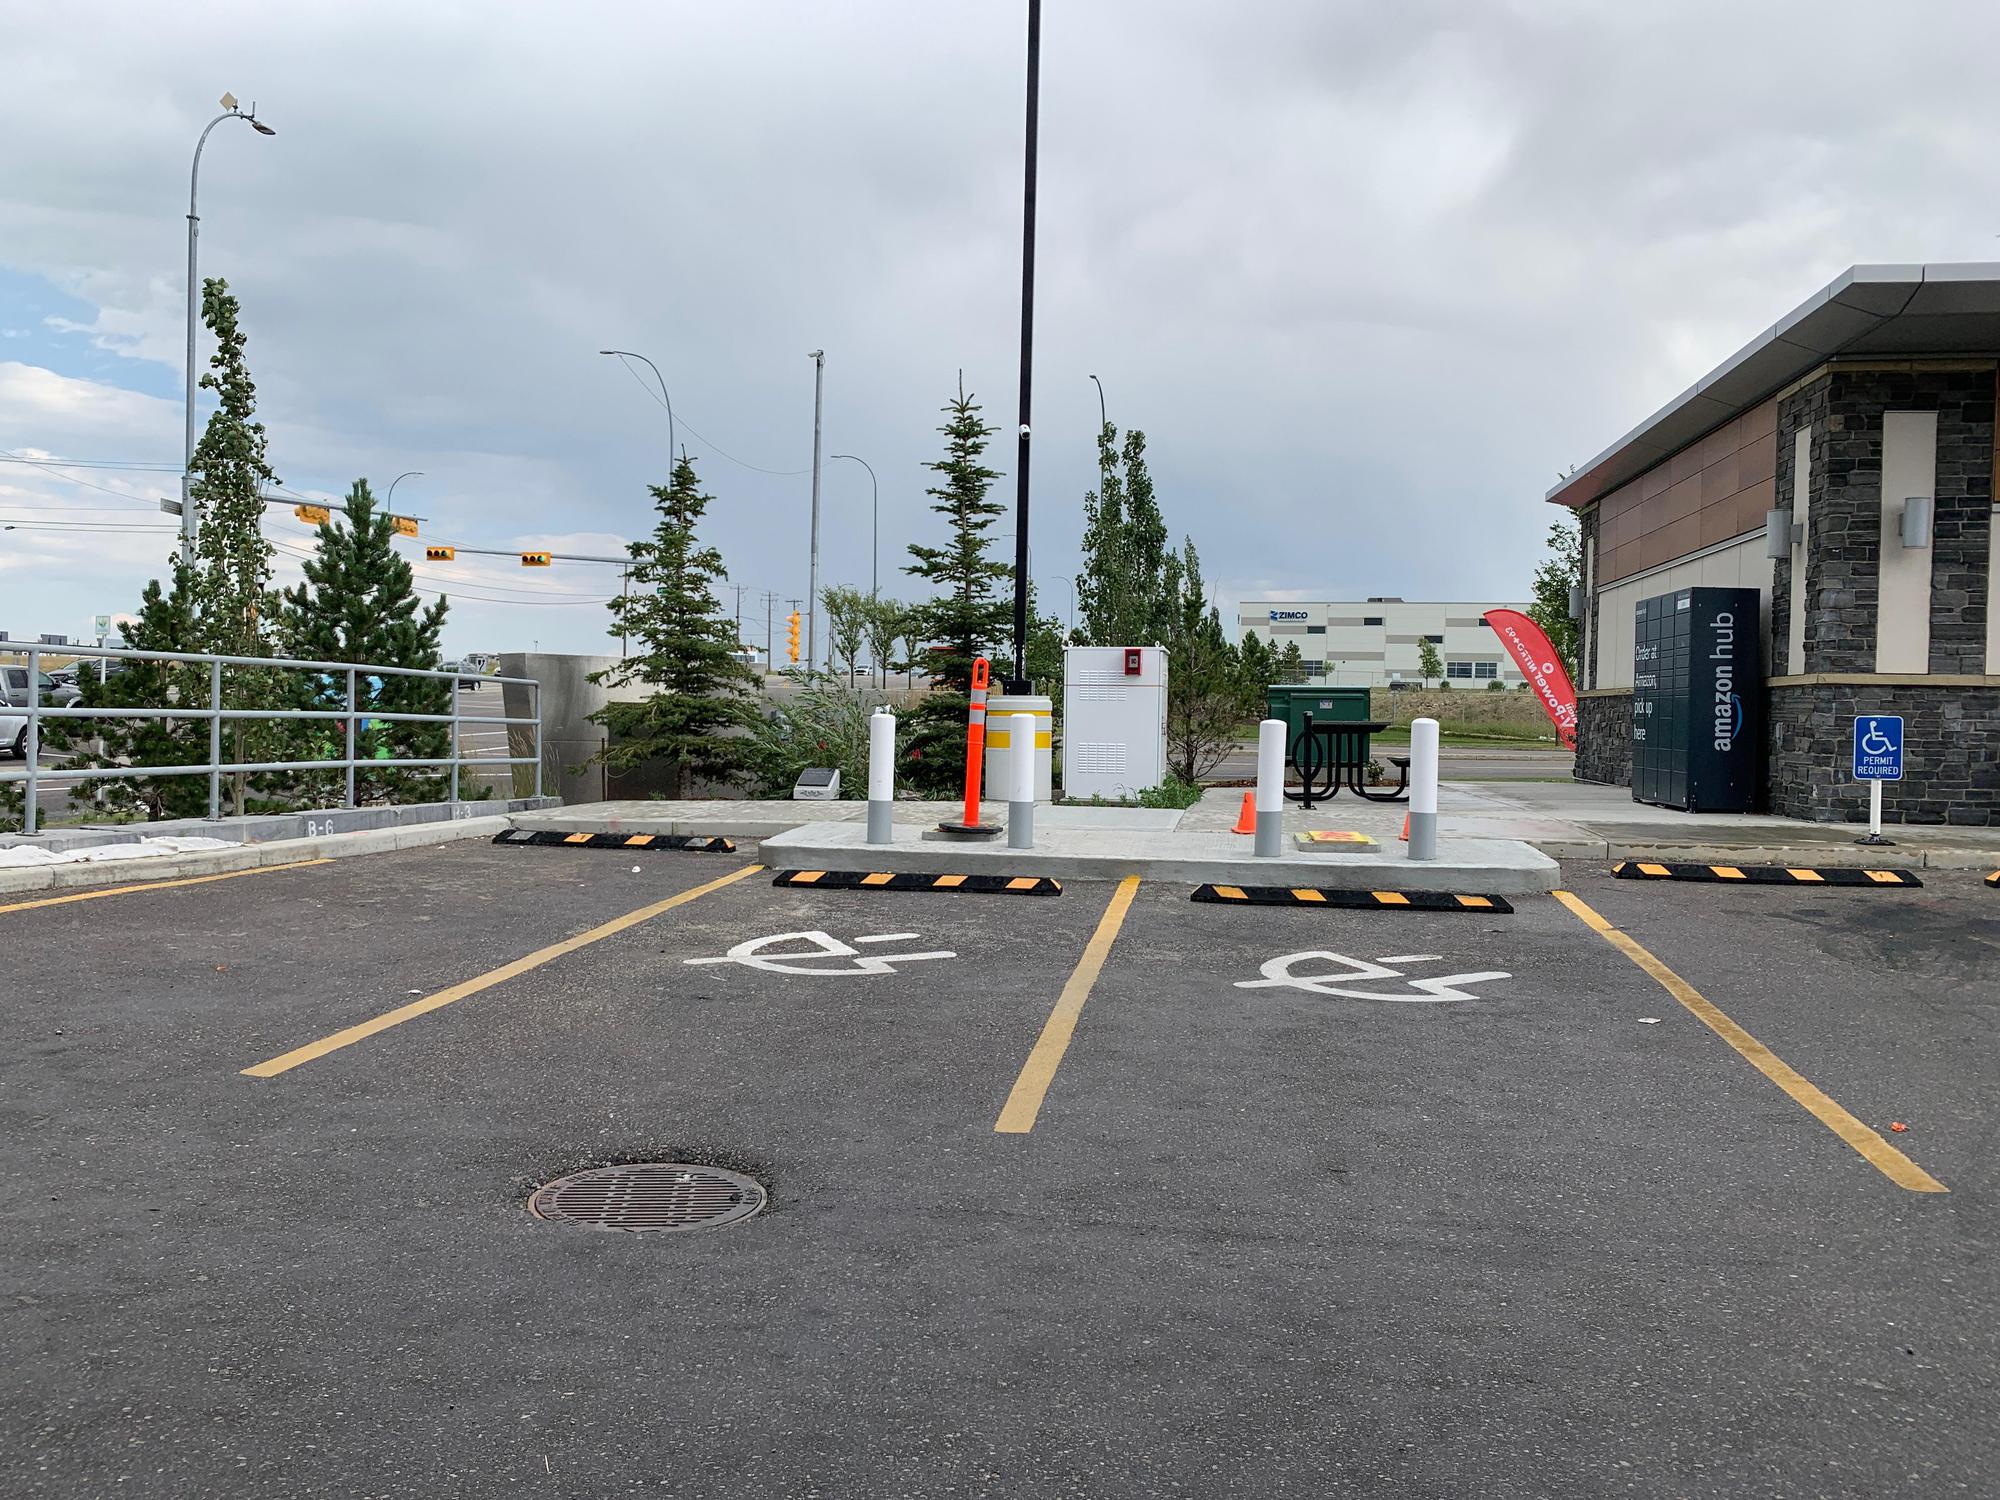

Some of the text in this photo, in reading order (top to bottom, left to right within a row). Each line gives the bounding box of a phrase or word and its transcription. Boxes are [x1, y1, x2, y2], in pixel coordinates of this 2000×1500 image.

[1278, 611, 1308, 620] ZIMCO
[1635, 644, 1657, 661] Order at
[1709, 612, 1734, 752] amazon hub
[1634, 697, 1653, 718] pick up
[1633, 724, 1646, 740] here
[1863, 756, 1894, 765] PERMIT
[1857, 766, 1899, 775] REQUIRED
[308, 819, 334, 837] B-6
